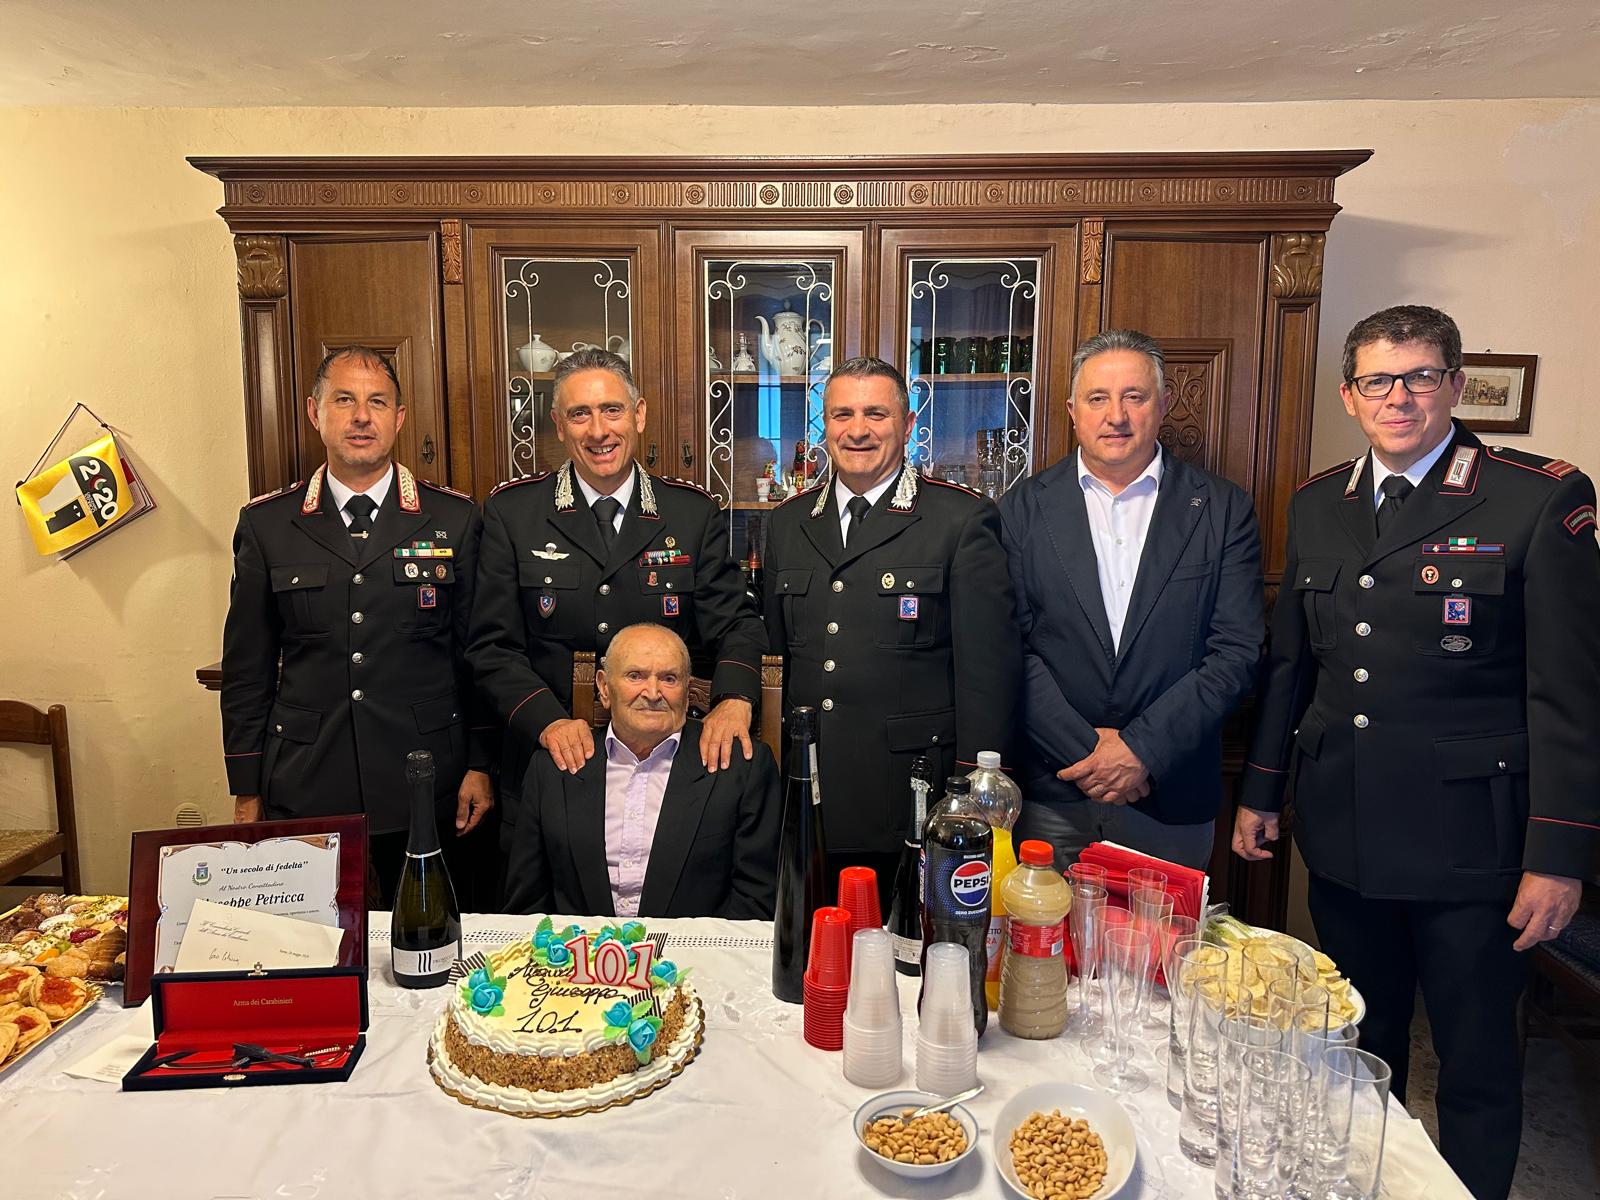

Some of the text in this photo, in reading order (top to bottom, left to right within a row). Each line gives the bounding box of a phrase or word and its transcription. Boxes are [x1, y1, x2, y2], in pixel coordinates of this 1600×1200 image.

[240, 865, 264, 873] secolo
[953, 876, 989, 888] PEPSI
[255, 891, 305, 906] Petricca
[564, 934, 655, 990] 101
